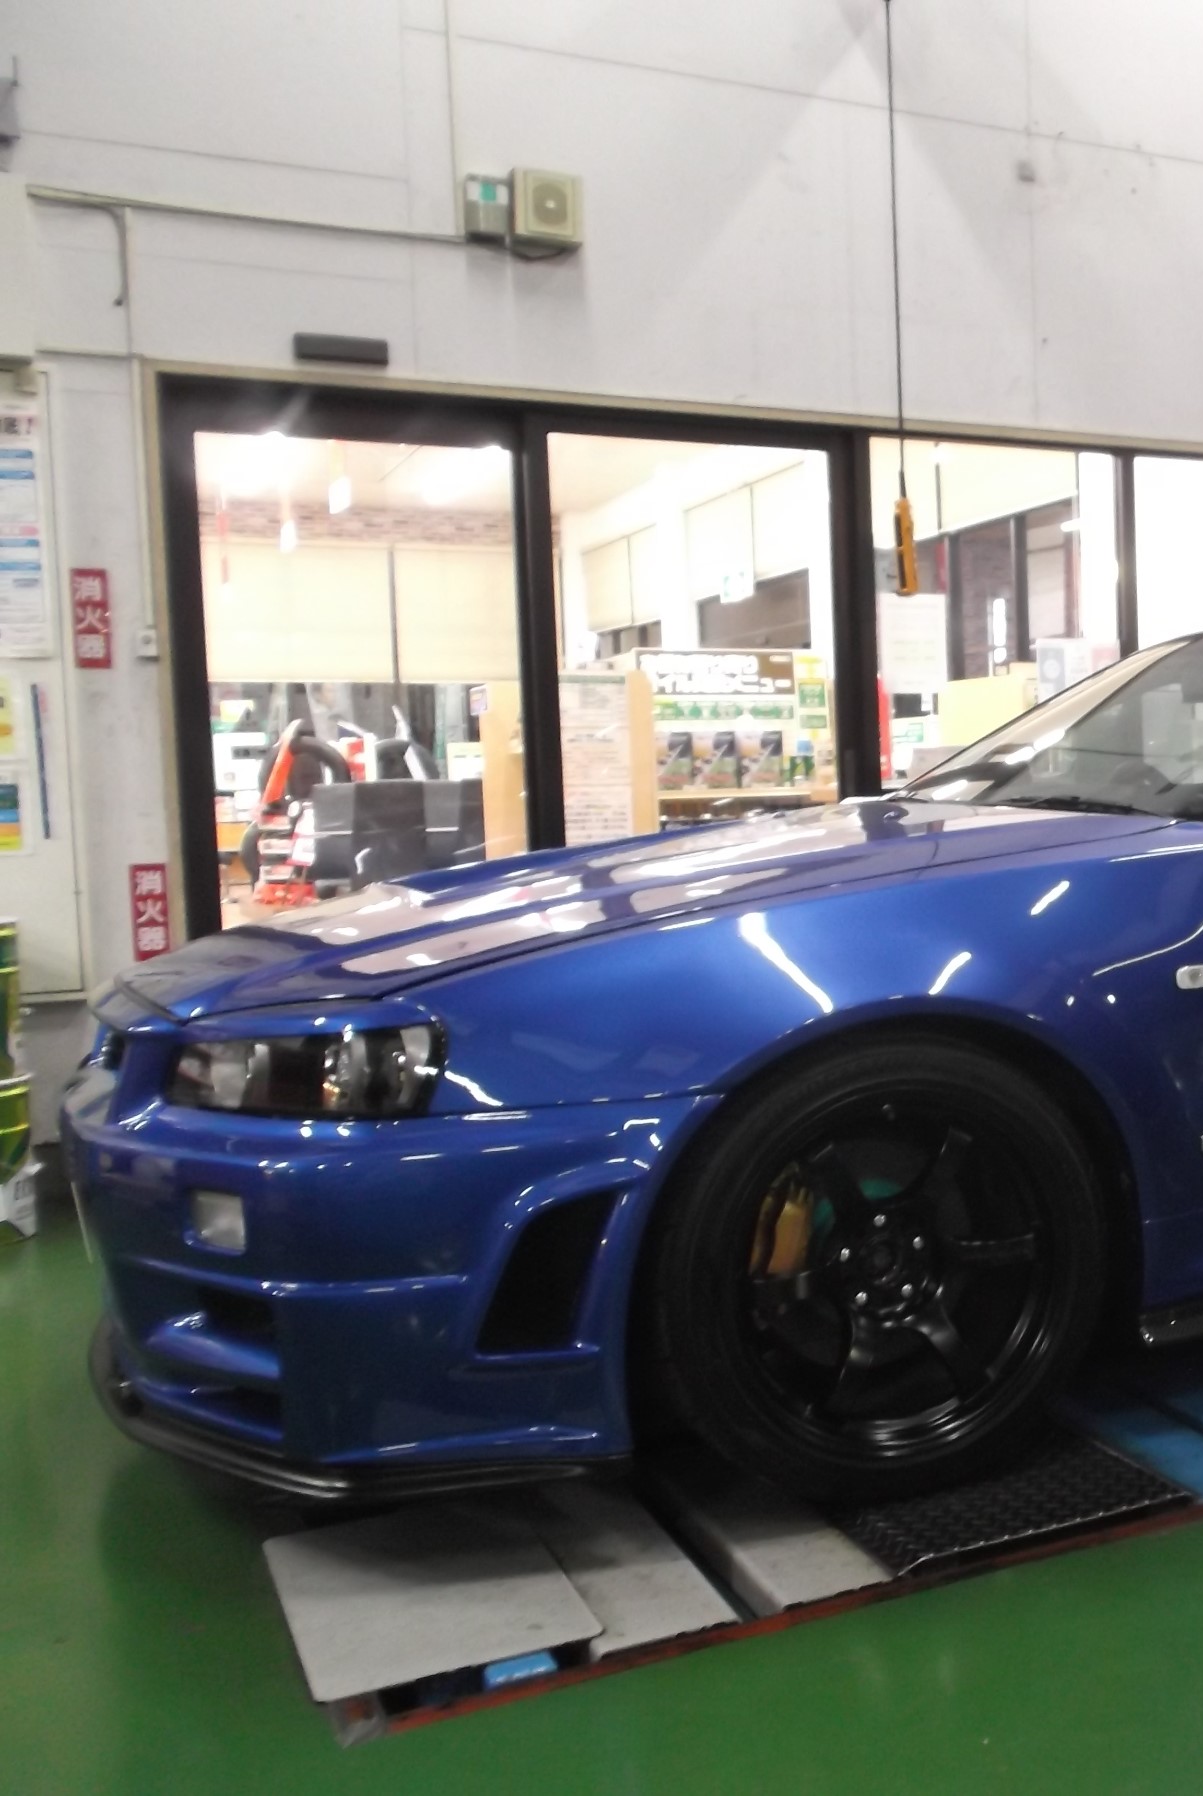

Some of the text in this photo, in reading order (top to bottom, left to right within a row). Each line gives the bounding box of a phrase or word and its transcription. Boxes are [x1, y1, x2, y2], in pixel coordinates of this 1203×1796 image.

[73, 576, 105, 658] 消火器
[135, 870, 165, 951] 消火器
